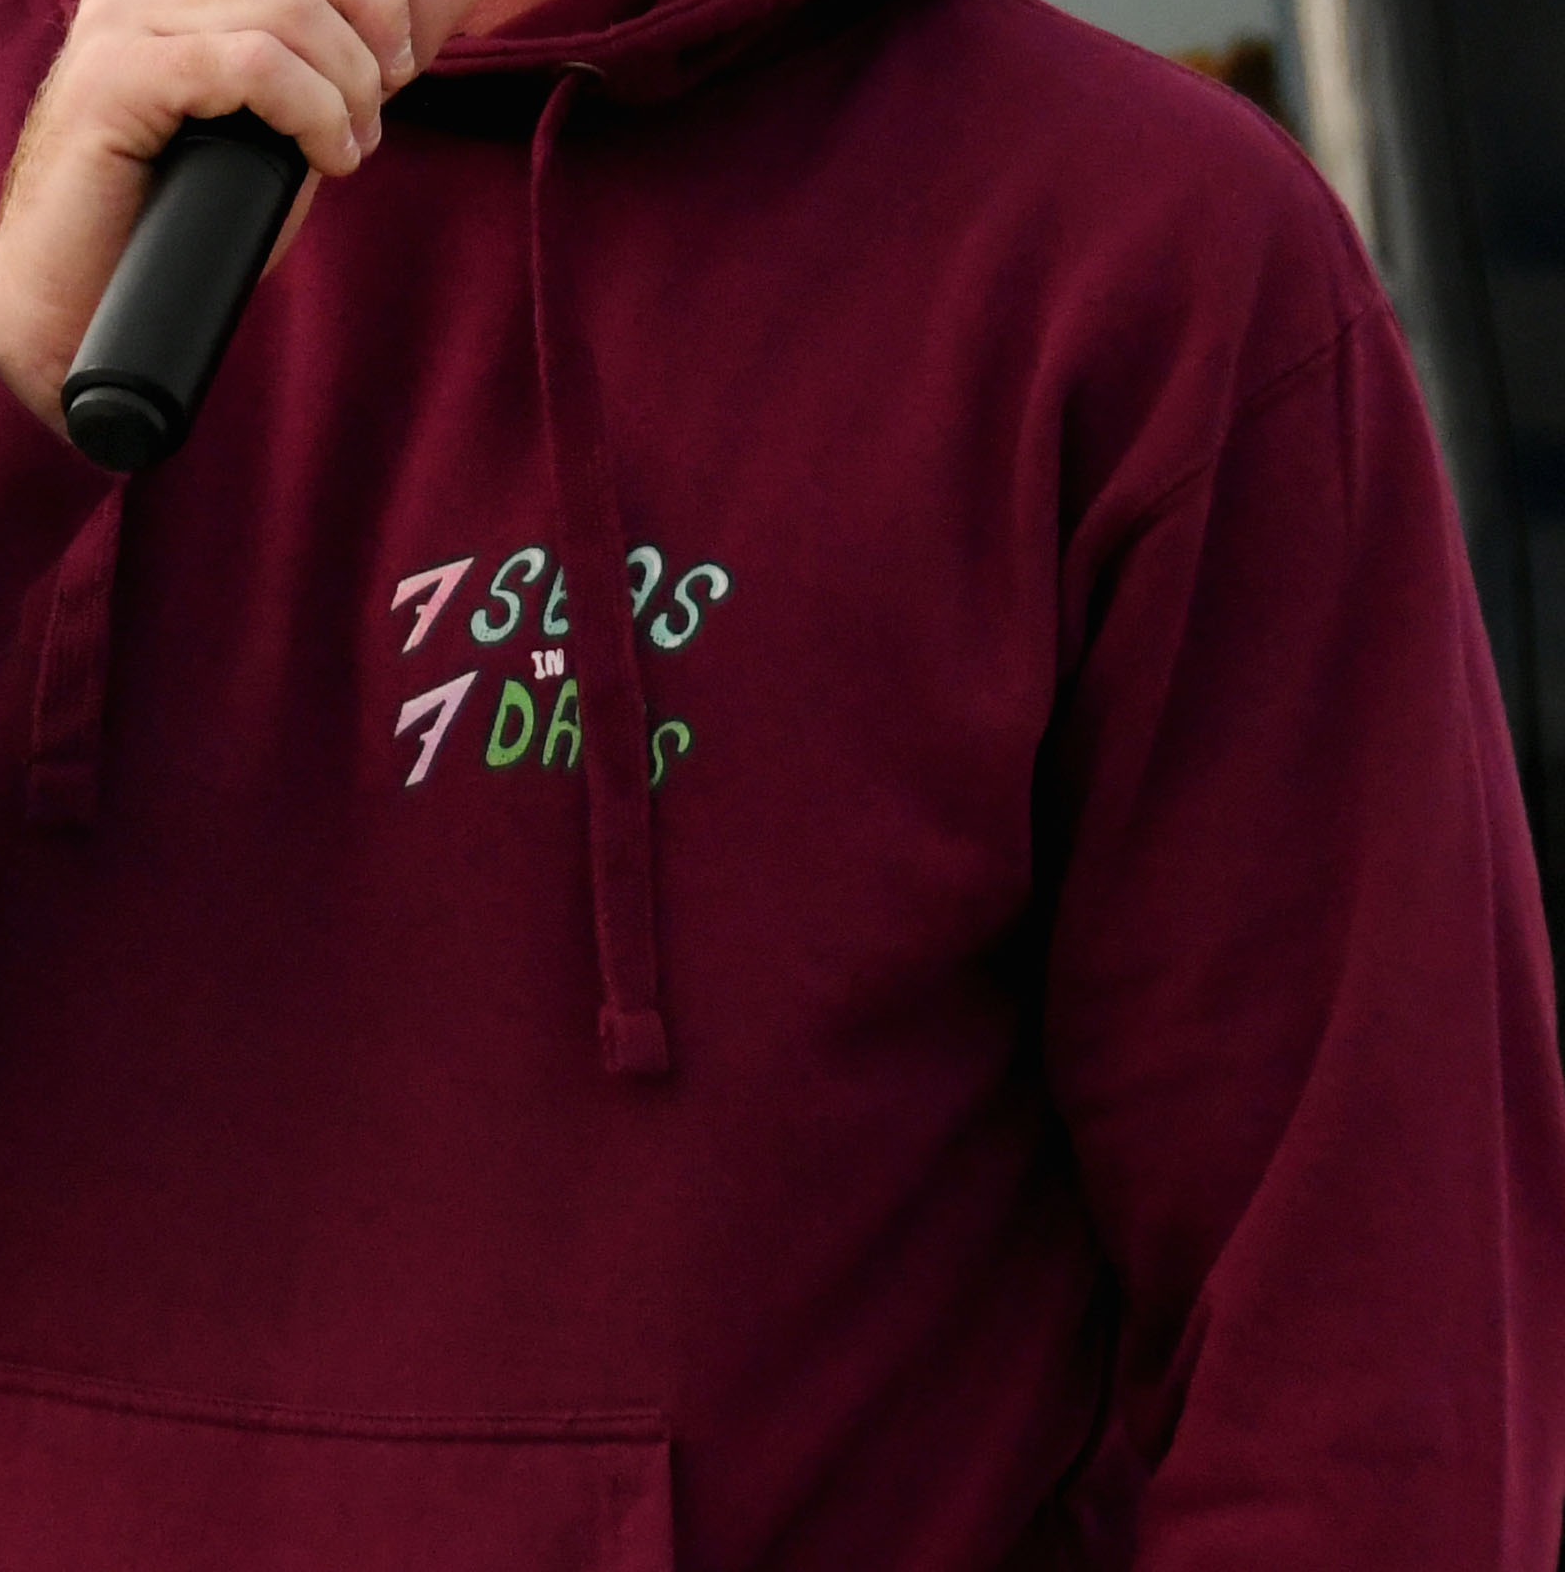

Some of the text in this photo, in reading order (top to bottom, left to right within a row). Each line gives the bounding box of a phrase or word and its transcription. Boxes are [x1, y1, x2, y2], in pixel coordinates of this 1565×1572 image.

[390, 556, 475, 654] 7
[530, 648, 566, 679] IN
[393, 670, 691, 787] 7 DAS
